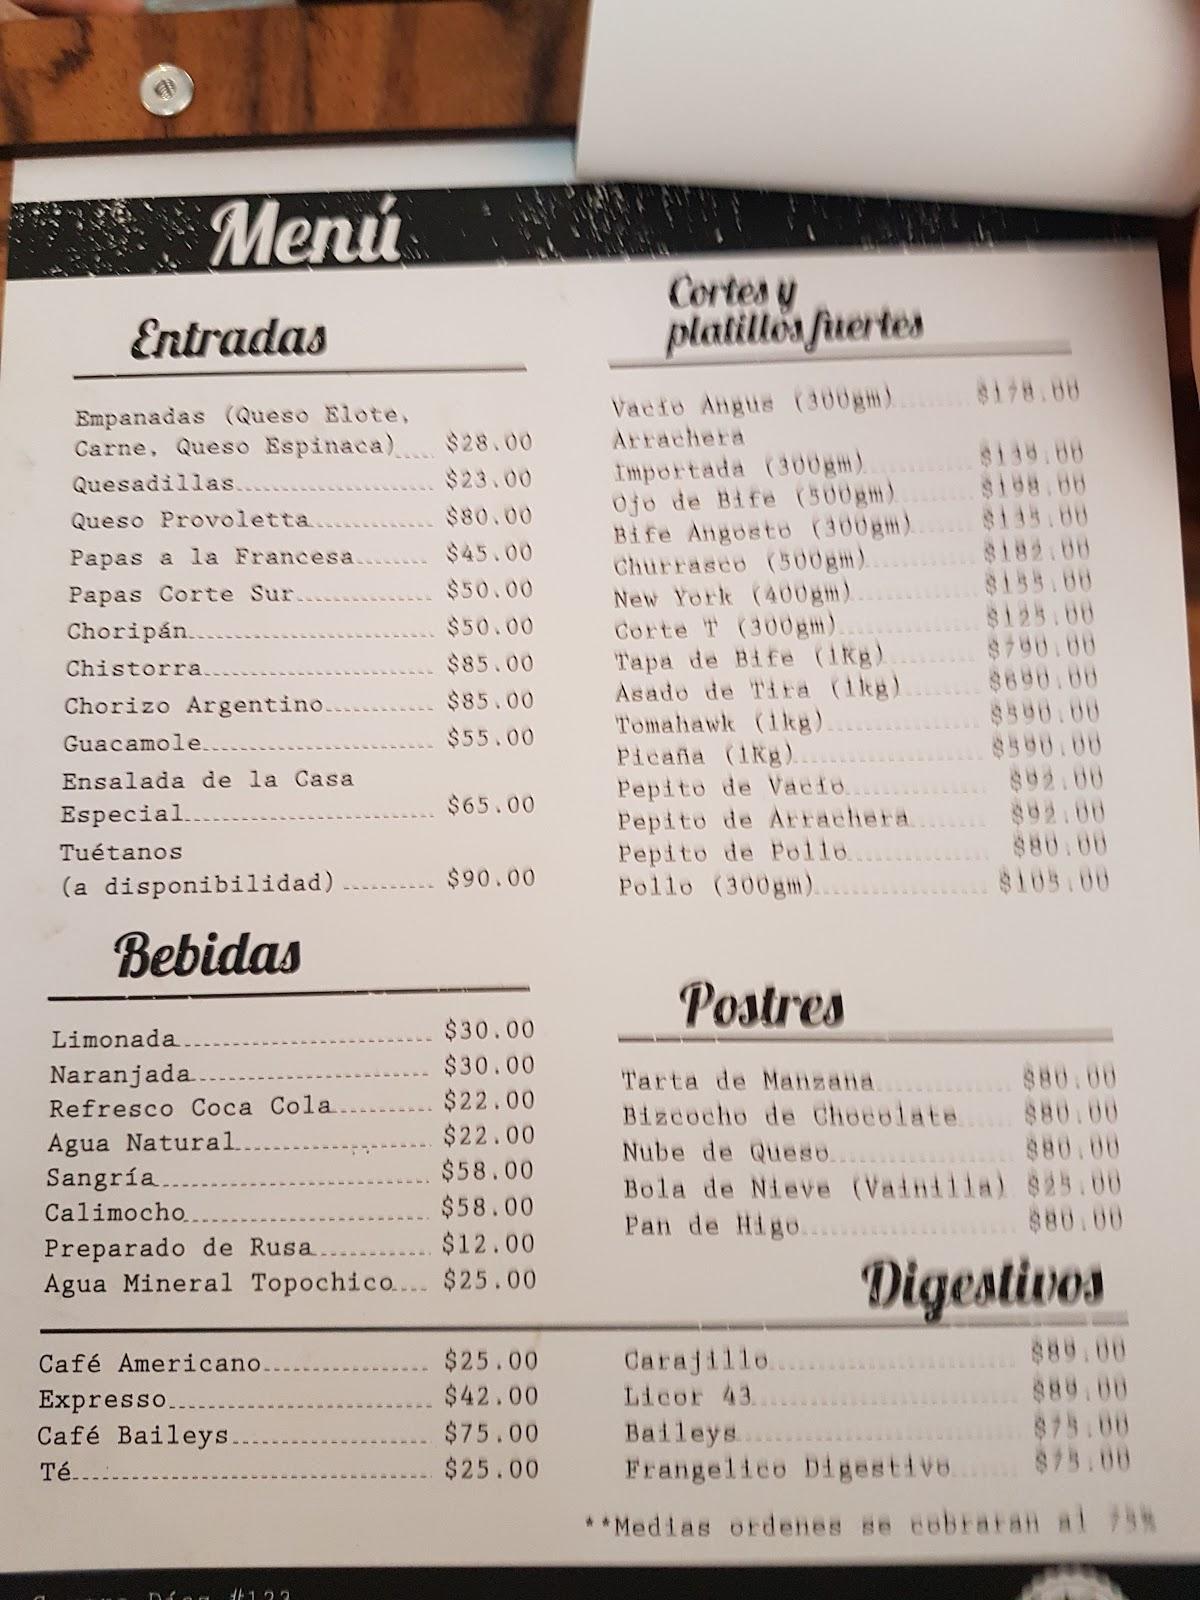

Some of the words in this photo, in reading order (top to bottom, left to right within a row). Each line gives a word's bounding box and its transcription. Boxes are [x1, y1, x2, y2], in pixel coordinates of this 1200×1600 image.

[211, 195, 402, 266] Menú
[669, 274, 769, 308] Cortes
[777, 277, 798, 314] y
[130, 317, 327, 359] Entradas
[666, 309, 801, 359] platillos
[804, 304, 923, 353] fuertes
[76, 409, 206, 427] Empanadas
[226, 405, 308, 426] (Queso
[326, 406, 410, 424] Elote,
[701, 392, 774, 416] Angus
[75, 440, 157, 458] Carne,
[177, 438, 249, 457] Queso
[266, 436, 395, 457] Espinaca)
[446, 432, 533, 453] $28.00
[613, 427, 745, 450] Arrachera
[73, 473, 234, 494] Quesadillas
[446, 469, 533, 489] $23.00
[615, 458, 745, 484] Importada
[614, 494, 656, 516] Ojo
[672, 490, 700, 512] de
[719, 489, 776, 510] Bife
[71, 511, 144, 530] Queso
[162, 510, 309, 529] Provoletta
[446, 506, 533, 527] $80.00
[614, 523, 671, 544] Bife
[688, 518, 792, 546] Angosto
[71, 549, 144, 569] Papas
[160, 551, 174, 565] a
[192, 548, 219, 565] la
[235, 548, 354, 565] Francesa
[447, 542, 533, 563] $45.00
[615, 553, 747, 577] Churrasco
[70, 586, 143, 606] Papas
[160, 586, 234, 603] Corte
[251, 585, 294, 601] Sur
[447, 579, 533, 600] $50.00
[614, 591, 657, 609] New
[675, 589, 733, 607] York
[67, 621, 187, 642] Choripán
[448, 616, 534, 637] $50.00
[615, 621, 688, 640] Corte
[704, 619, 718, 638] T
[66, 659, 202, 677] Chistorra
[448, 653, 534, 674] $85.00
[614, 653, 674, 675] Tapa
[690, 649, 718, 670] de
[736, 649, 794, 667] Bife
[65, 697, 170, 715] Chorizo
[186, 695, 323, 717] Argentino
[448, 690, 534, 711] $85.00
[615, 682, 688, 703] Asado
[706, 681, 734, 702] de
[751, 678, 810, 700] Tira
[615, 714, 736, 735] Tomahawk
[64, 733, 201, 752] Guacamole
[448, 727, 535, 748] $55.00
[617, 746, 705, 767] Picaña
[63, 772, 186, 791] Ensalada
[203, 771, 232, 789] de
[250, 770, 278, 788] la
[295, 770, 354, 787] Casa
[617, 779, 705, 803] Pepito
[722, 777, 752, 797] de
[61, 804, 184, 827] Especial
[448, 795, 535, 815] $65.00
[617, 811, 706, 835] Pepito
[723, 809, 753, 829] de
[769, 807, 909, 828] Arrachera
[60, 841, 182, 861] Tuétanos
[618, 843, 707, 868] Pepito
[724, 842, 754, 862] de
[771, 839, 847, 861] Pollo
[63, 876, 88, 898] (a
[105, 872, 335, 897] disponibilidad)
[448, 868, 536, 889] $90.00
[619, 875, 693, 897] Pollo
[114, 931, 301, 979] Bebidas
[680, 980, 845, 1029] Postres
[52, 1029, 177, 1049] Limonada
[445, 1018, 535, 1041] $30.00
[50, 1064, 191, 1088] Naranjada
[445, 1054, 535, 1077] $30.00
[622, 1070, 699, 1092] Tarta
[716, 1069, 746, 1091] de
[763, 1069, 875, 1092] Manzana
[50, 1099, 174, 1119] Refresco
[192, 1097, 253, 1117] Coca
[271, 1096, 332, 1116] Cola
[445, 1090, 535, 1112] $22.00
[623, 1106, 747, 1128] Bizcocho
[765, 1105, 796, 1128] de
[813, 1102, 957, 1129] Chocolate
[48, 1134, 110, 1158] Agua
[126, 1132, 236, 1152] Natural
[444, 1125, 535, 1148] $22.00
[623, 1142, 685, 1164] Nube
[702, 1140, 733, 1163] de
[751, 1140, 829, 1165] Queso
[46, 1167, 156, 1191] Sangría
[442, 1160, 534, 1183] $58.00
[624, 1177, 686, 1200] Bola
[704, 1176, 735, 1199] de
[752, 1175, 831, 1199] Nieve
[1027, 1169, 1121, 1198] $25.00
[46, 1202, 186, 1222] Calimocho
[442, 1196, 534, 1219] $58.00
[625, 1215, 672, 1236] Pan
[689, 1213, 720, 1236] de
[736, 1211, 800, 1241] Higo
[45, 1238, 186, 1261] Preparado
[203, 1237, 234, 1258] de
[250, 1238, 312, 1257] Rusa
[442, 1233, 535, 1256] $12.00
[44, 1274, 107, 1298] Agua
[124, 1273, 233, 1293] Mineral
[252, 1271, 393, 1298] Topochico
[444, 1270, 536, 1292] $25.00
[861, 1255, 1104, 1324] Digestivos
[39, 1353, 101, 1374] Café
[118, 1353, 261, 1374] Americano
[445, 1349, 538, 1372] $25.00
[625, 1348, 768, 1376] Carajillo
[39, 1390, 167, 1412] Expresso
[445, 1384, 538, 1408] $42.00
[624, 1386, 703, 1408] Licor
[723, 1385, 753, 1407] 43
[38, 1425, 101, 1447] Café
[118, 1425, 229, 1449] Baileys
[445, 1421, 539, 1445] $75.00
[626, 1421, 737, 1447] Baileys
[40, 1461, 71, 1482] Té
[445, 1458, 539, 1481] $25.00
[626, 1457, 787, 1485] Frangelico
[805, 1455, 950, 1483] Digestivo
